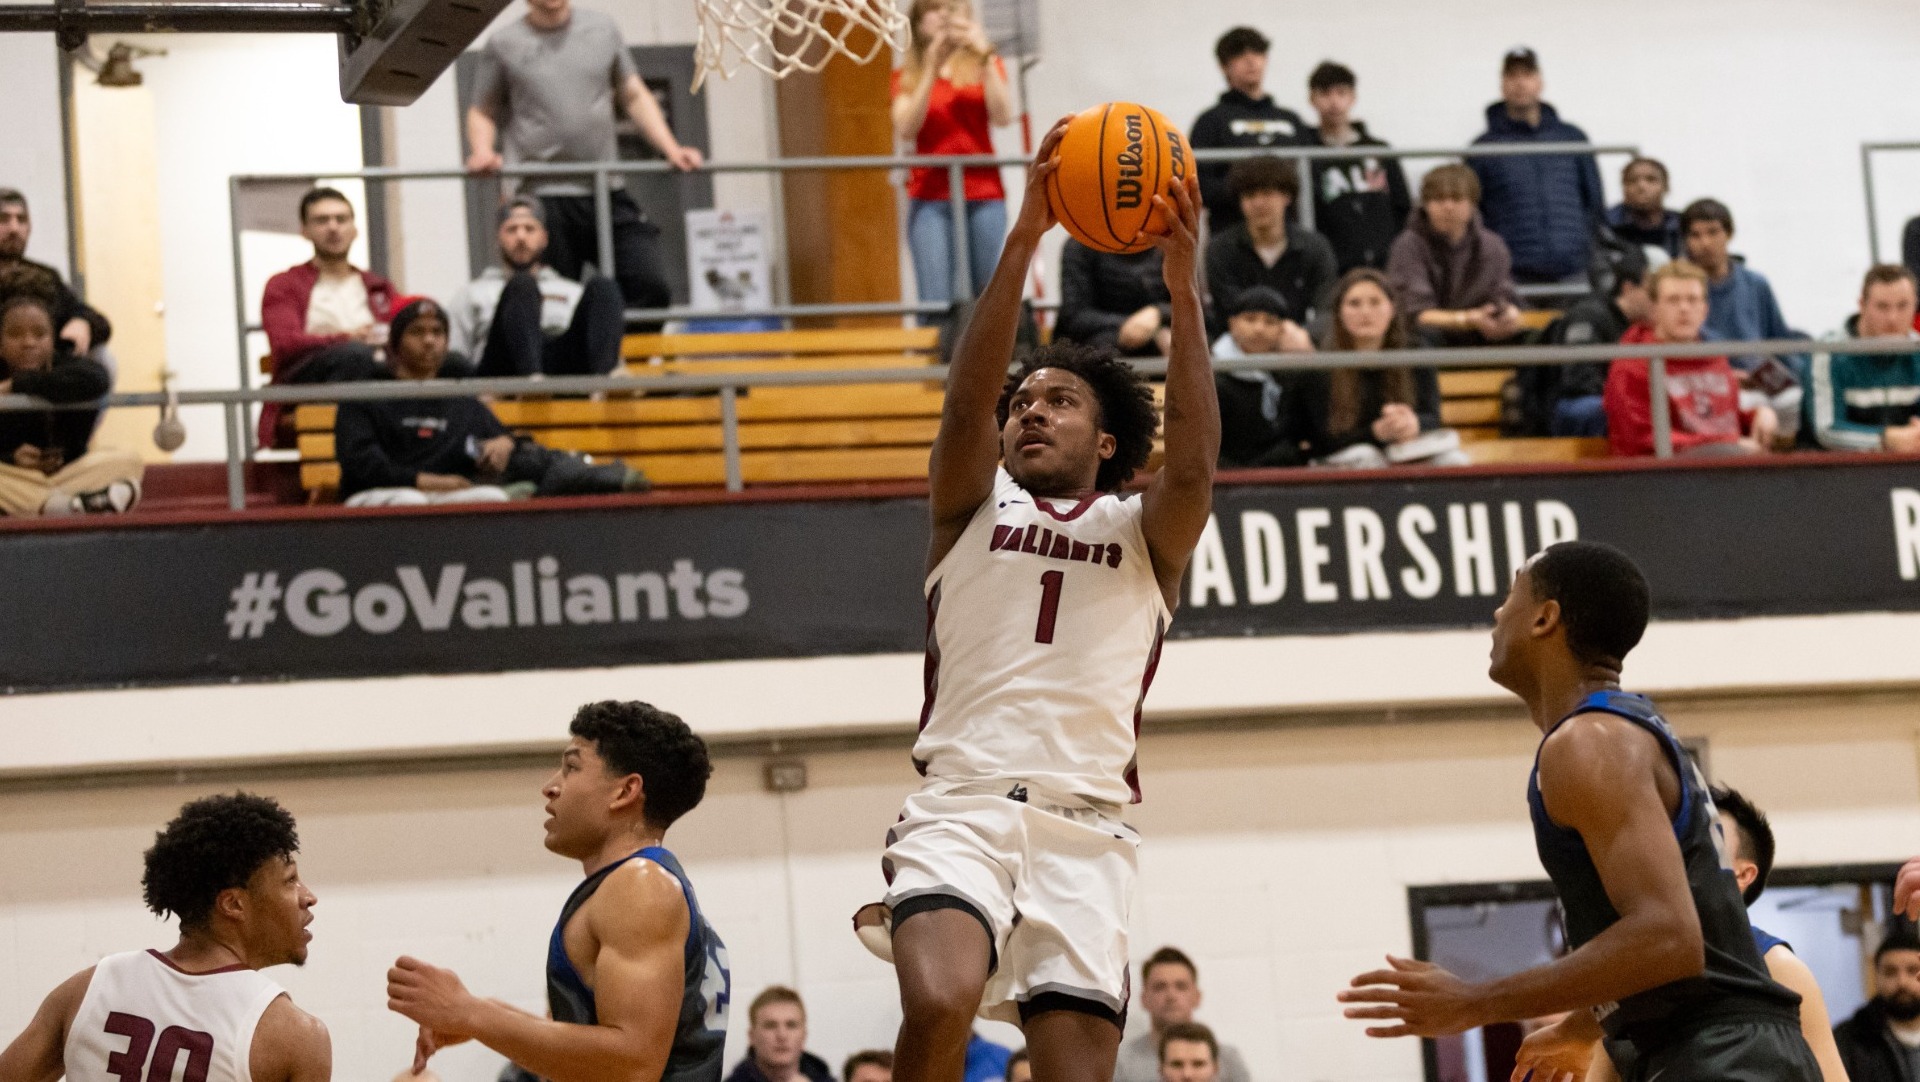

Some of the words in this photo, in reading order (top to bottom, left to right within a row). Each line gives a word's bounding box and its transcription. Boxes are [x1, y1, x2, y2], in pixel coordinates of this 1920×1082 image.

[1116, 114, 1144, 211] Wilson
[1167, 131, 1186, 197] CAA
[989, 524, 1123, 569] VALIANTS
[1190, 500, 1578, 607] ADERSHIP
[224, 556, 750, 639] #GoValiants
[1035, 569, 1064, 644] 1
[103, 1011, 215, 1082] 30
